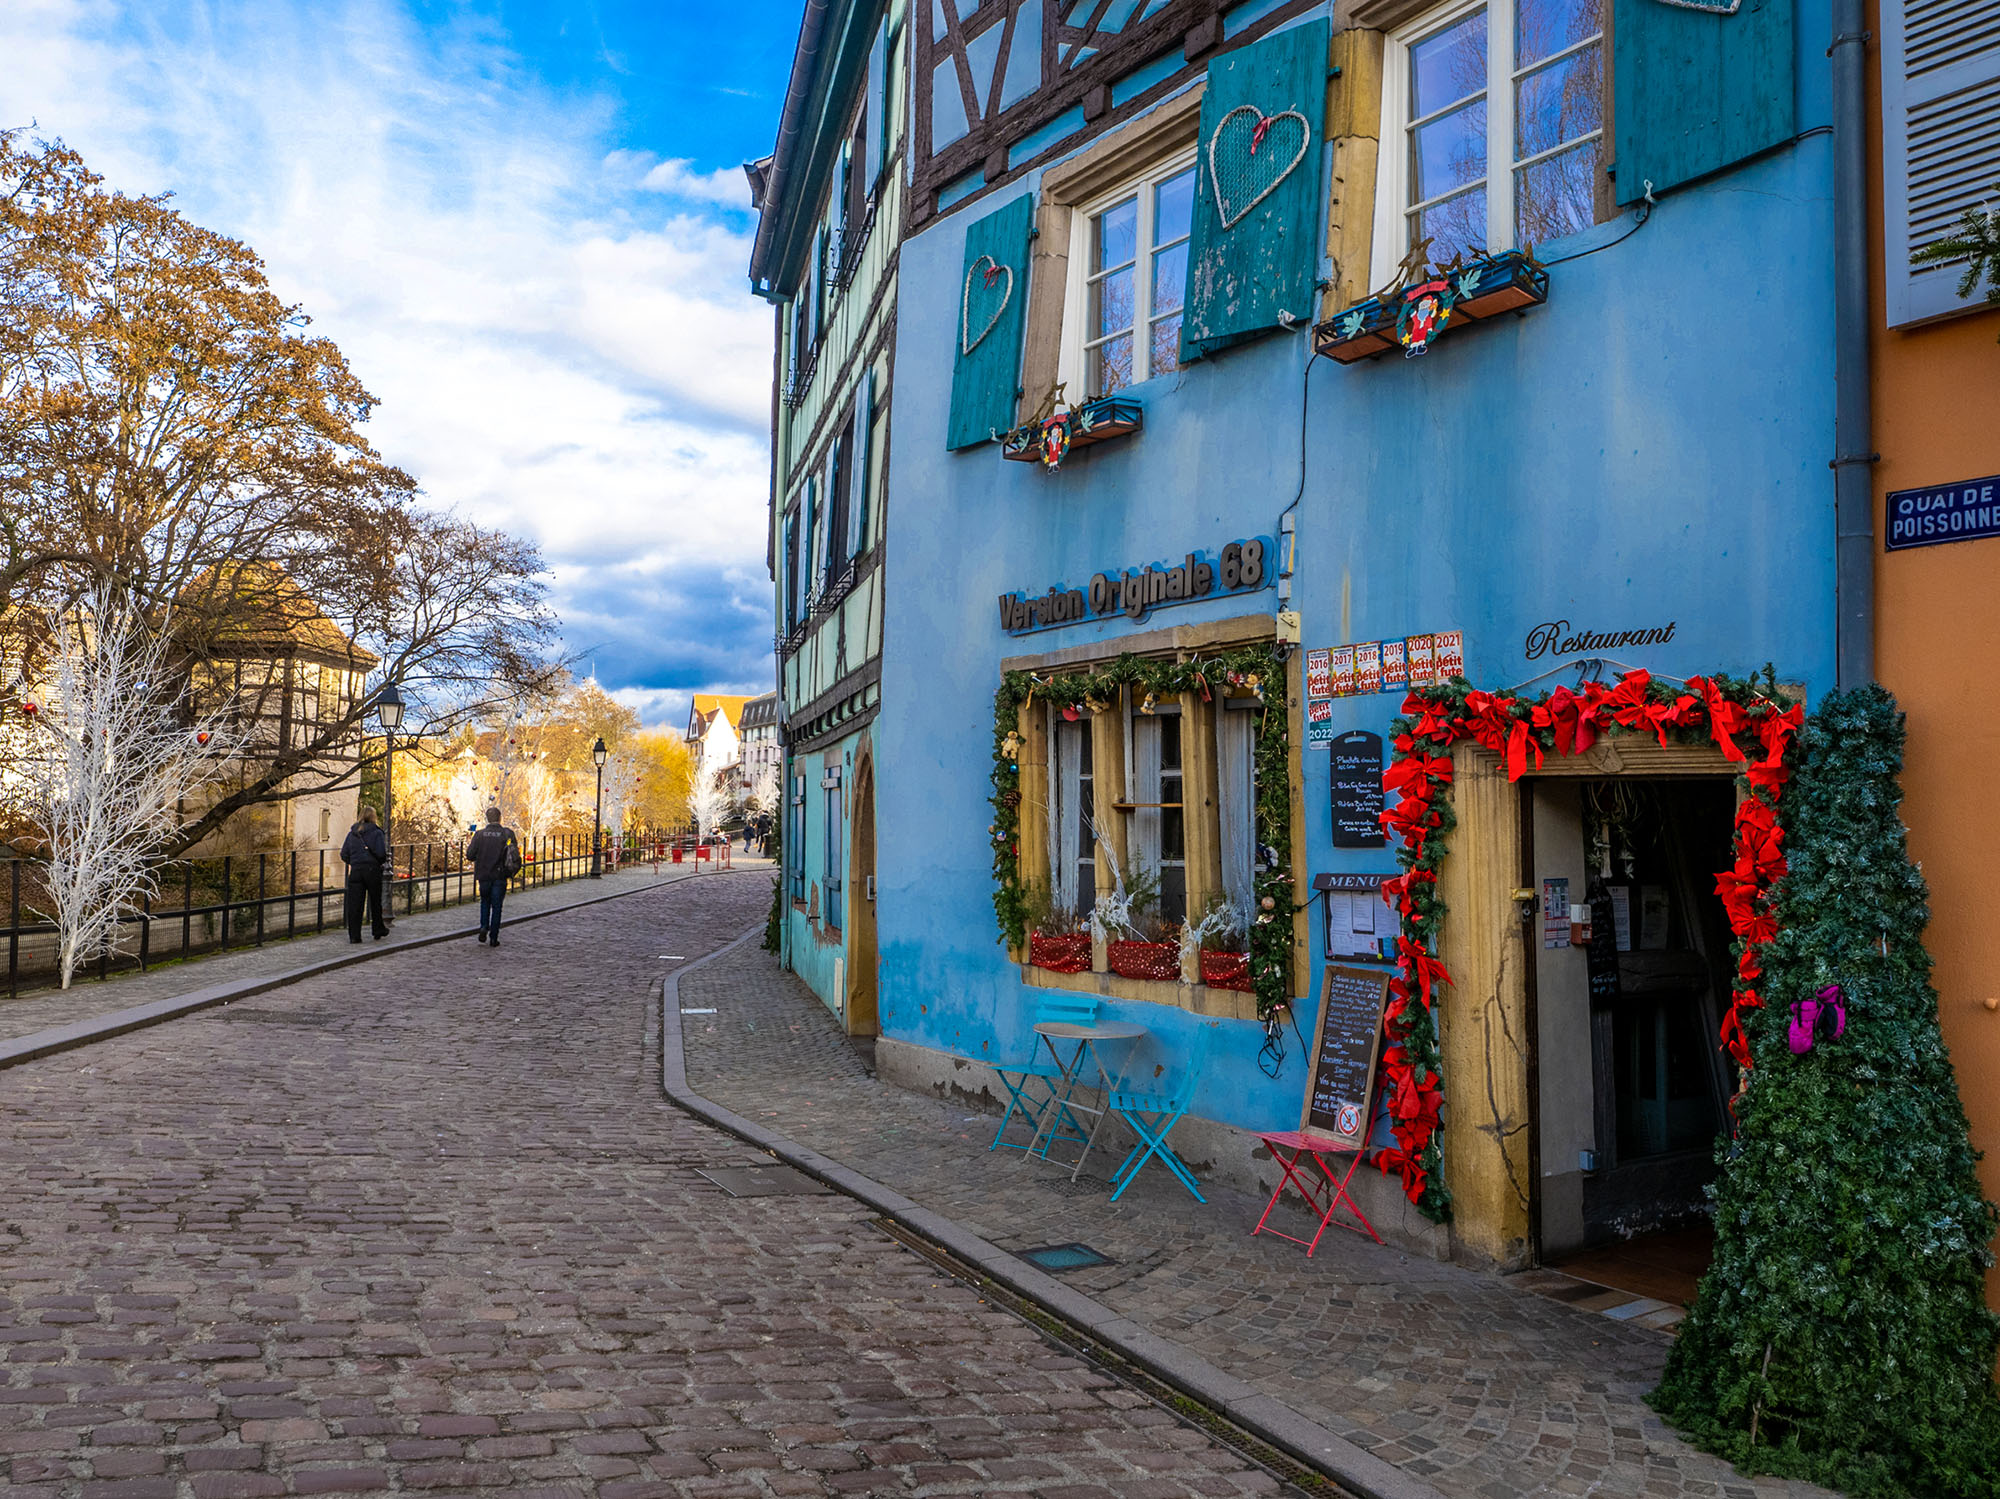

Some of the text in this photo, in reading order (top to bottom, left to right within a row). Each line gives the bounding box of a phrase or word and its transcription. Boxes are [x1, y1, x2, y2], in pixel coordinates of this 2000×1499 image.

[1898, 485, 1994, 515] QUAI DE
[1893, 505, 2000, 539] POISSONNE
[998, 539, 1264, 630] Version Originale 68
[1408, 637, 1433, 652] 2020
[1436, 634, 1460, 648] 2021
[1525, 619, 1676, 661] Restaurant
[1359, 650, 1377, 662] 2018
[1384, 643, 1403, 656] 2019
[1310, 659, 1328, 670] 2016
[1334, 654, 1352, 665] 2017
[1408, 658, 1433, 672] petit
[1436, 655, 1462, 670] petit
[1382, 662, 1406, 676] petit
[1309, 729, 1332, 740] 2022
[1328, 876, 1380, 887] MENU
